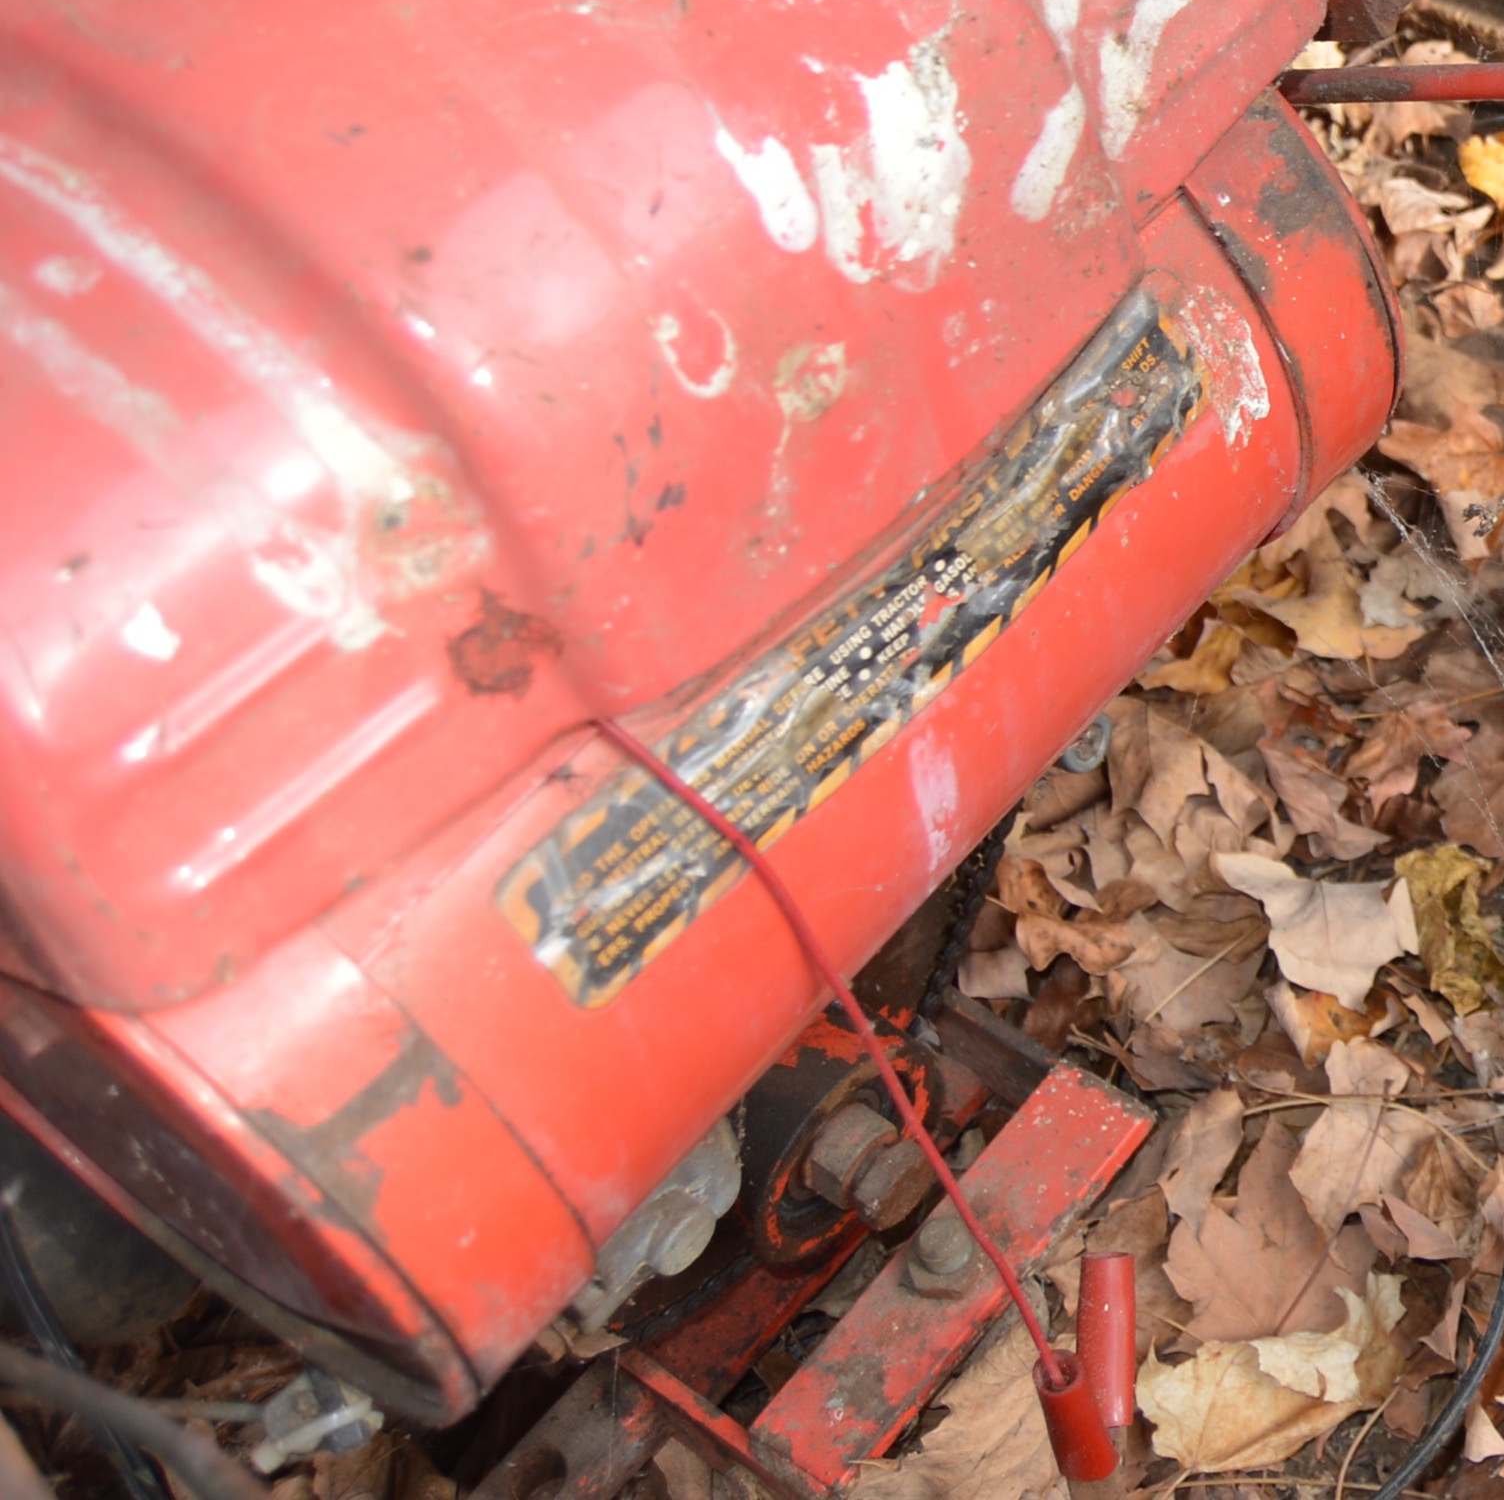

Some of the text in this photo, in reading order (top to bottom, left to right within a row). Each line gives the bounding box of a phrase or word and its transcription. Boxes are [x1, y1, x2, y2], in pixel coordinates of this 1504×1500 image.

[592, 839, 628, 875] THE
[711, 712, 773, 770] MANUAL
[827, 622, 872, 665] USING
[868, 571, 929, 629] TRACTOR
[1120, 335, 1151, 373] SHIFT
[875, 630, 912, 667] KEEP
[1060, 447, 1095, 486] FROM
[903, 469, 1005, 570] FIRST
[602, 886, 655, 938] NEVER
[755, 762, 792, 797] RIDE
[791, 738, 817, 765] ON
[815, 718, 839, 743] OR
[1067, 450, 1114, 503] DANGER
[1130, 410, 1148, 432] BY
[600, 827, 668, 890] NEUTRAL
[631, 858, 705, 935] PROPER
[742, 774, 802, 829] TERRAIN
[803, 714, 869, 774] HAZARDS
